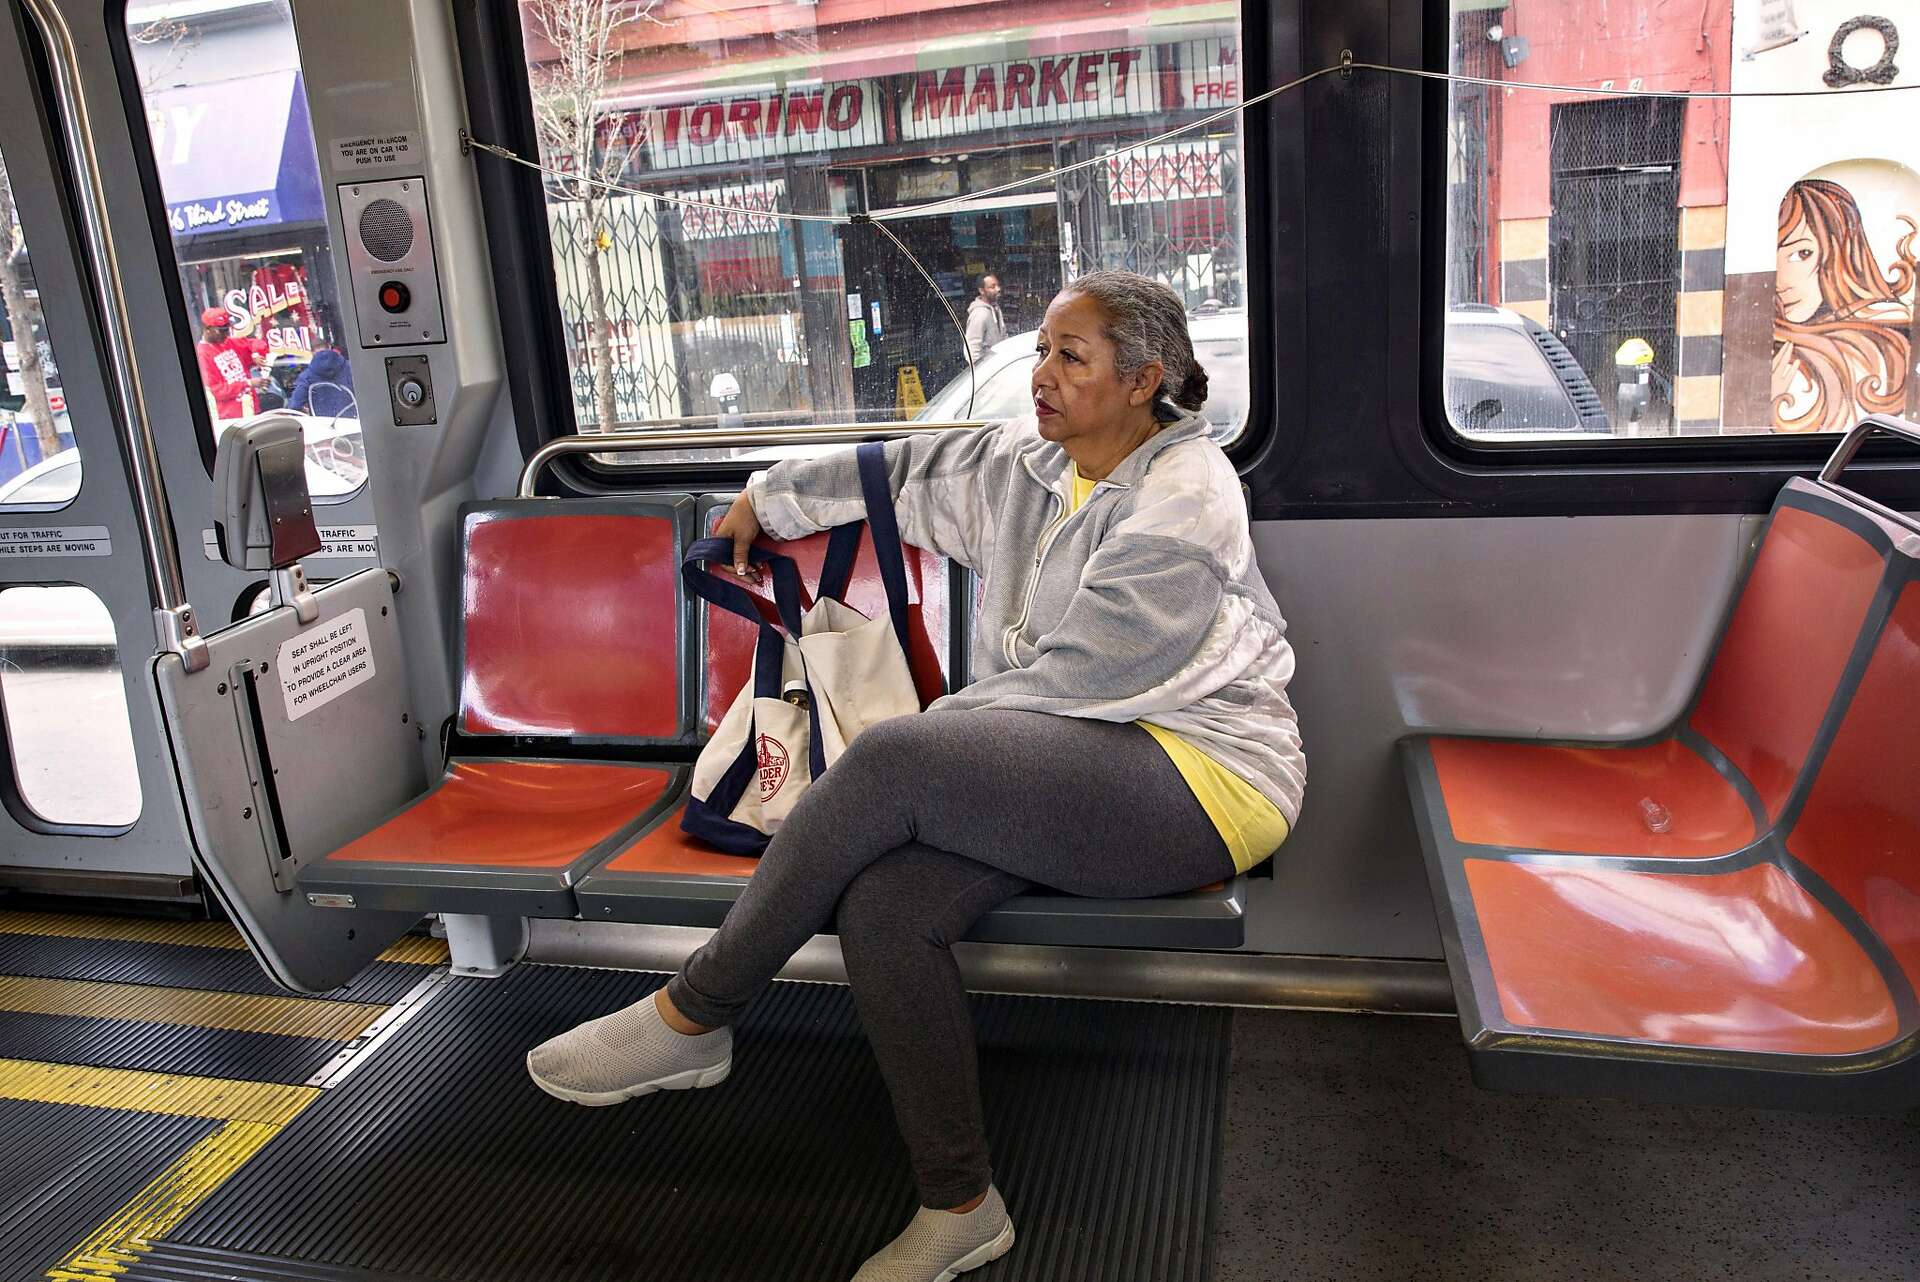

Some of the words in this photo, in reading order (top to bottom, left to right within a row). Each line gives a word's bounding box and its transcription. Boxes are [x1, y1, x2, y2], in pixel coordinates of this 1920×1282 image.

[661, 86, 863, 150] TORINO
[912, 50, 1141, 121] MARKET
[356, 148, 368, 156] ARE
[369, 147, 379, 155] ON
[380, 146, 394, 154] CAR
[356, 156, 372, 165] PUSH
[374, 155, 382, 163] TO
[384, 154, 397, 162] USE
[184, 203, 226, 229] Third
[226, 198, 269, 226] Street
[224, 281, 302, 338] SALE
[13, 531, 28, 540] FOR
[31, 530, 63, 539] TRAFFIC
[320, 529, 356, 538] TRAFFIC
[19, 545, 43, 553] STEPS
[46, 544, 61, 552] ARE
[65, 543, 96, 552] MOVING
[336, 544, 353, 552] ARE
[291, 646, 308, 659] SEAT
[309, 636, 329, 650] SHALL
[330, 632, 338, 641] BE
[339, 623, 353, 635] LEFT
[293, 665, 301, 674] IN
[302, 650, 328, 669] UPRIGHT
[330, 636, 357, 655] POSITION
[287, 682, 297, 693] TO
[298, 669, 325, 688] PROVIDE
[326, 665, 331, 673] A
[332, 655, 351, 670] CLEAR
[352, 646, 367, 659] AREA
[293, 693, 308, 706] FOR
[308, 672, 347, 698] WHEELCHAIR
[349, 661, 367, 676] USERS
[760, 779, 776, 792] E'S
